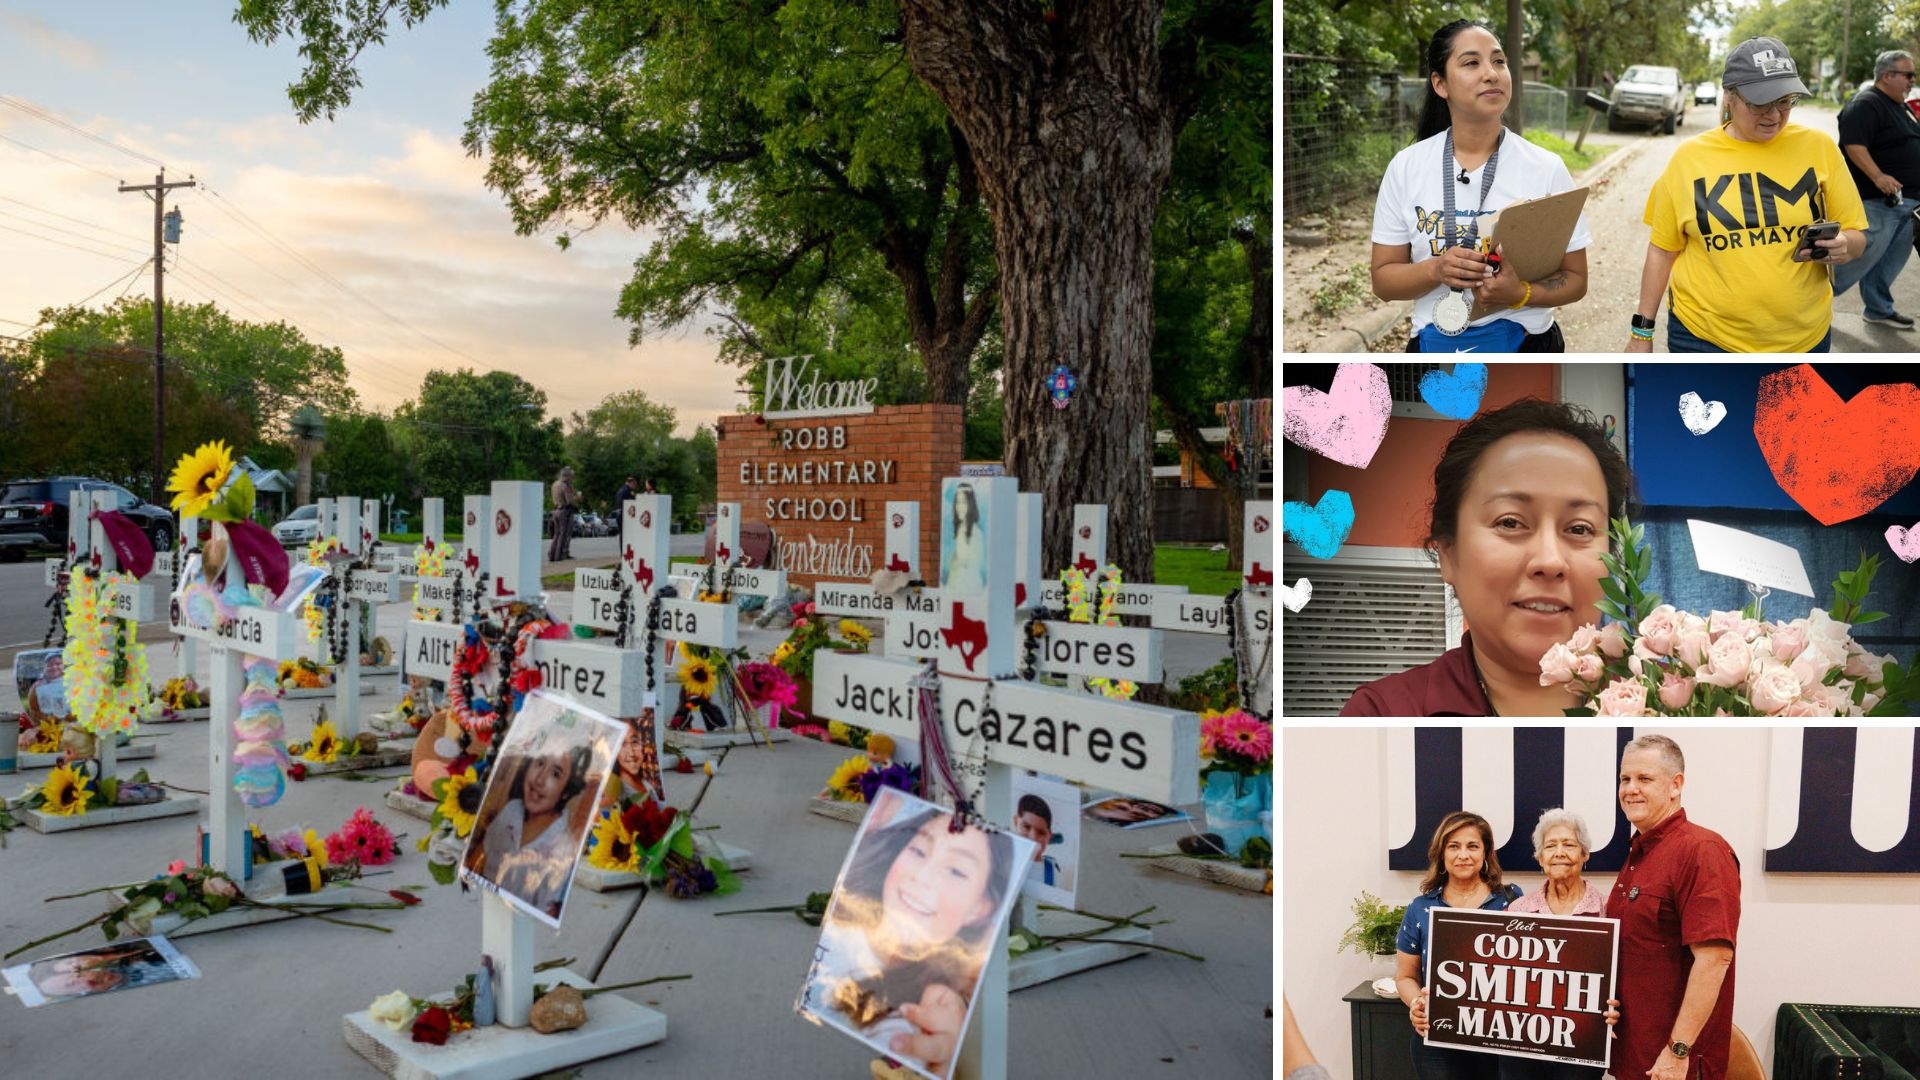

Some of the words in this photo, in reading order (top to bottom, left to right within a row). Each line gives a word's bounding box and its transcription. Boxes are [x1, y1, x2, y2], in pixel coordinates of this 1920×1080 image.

[1693, 167, 1822, 236] KIM
[1704, 231, 1743, 252] FOR
[764, 354, 879, 411] Welcome
[782, 426, 845, 450] ROBB
[765, 497, 863, 521] SCHOOL
[820, 591, 894, 610] Miranda
[648, 604, 697, 633] ata
[1044, 635, 1136, 667] lores
[954, 699, 1148, 770] Cazares
[1506, 919, 1538, 932] Elect
[1474, 933, 1567, 963] CODY
[1436, 960, 1604, 1014] SMITH
[1433, 1018, 1453, 1031] For
[1456, 1005, 1576, 1049] MAYOR
